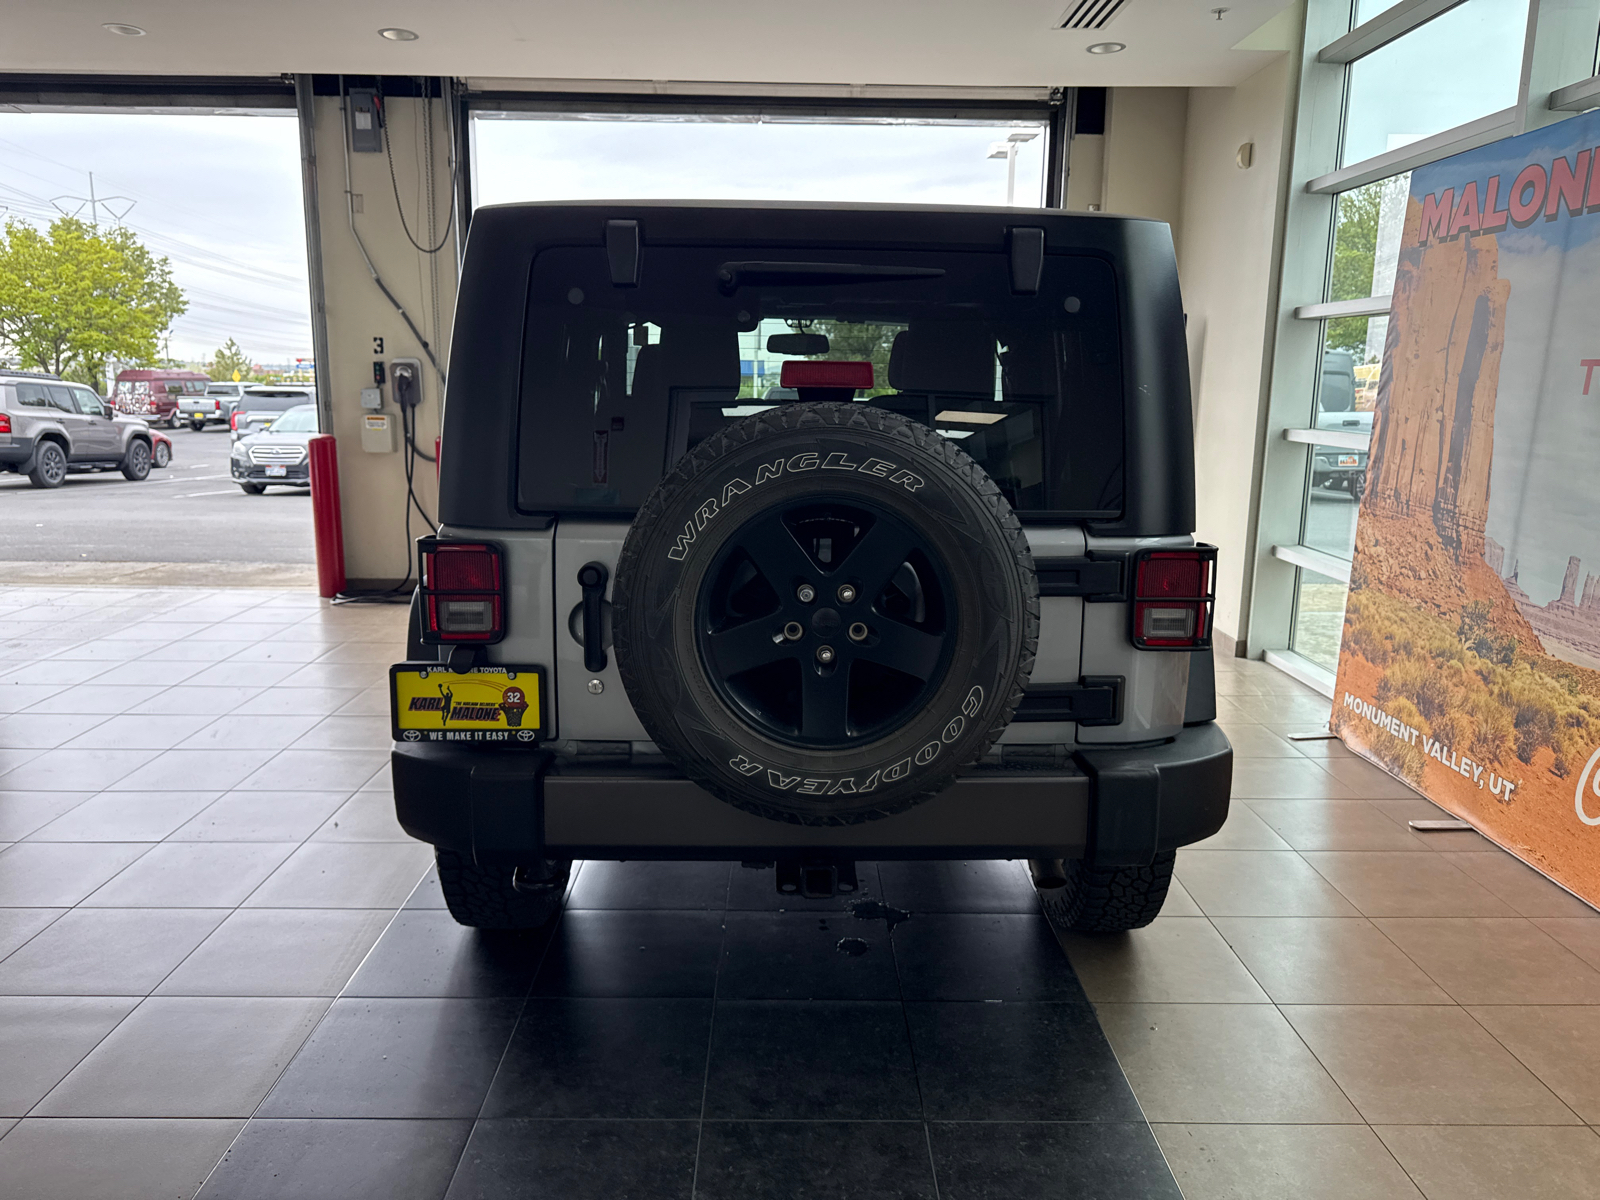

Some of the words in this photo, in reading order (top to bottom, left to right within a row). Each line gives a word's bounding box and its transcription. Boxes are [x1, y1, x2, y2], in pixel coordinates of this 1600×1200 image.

[373, 337, 384, 354] 3
[667, 452, 925, 561] WRANGLER
[408, 697, 443, 712] KARL
[507, 692, 521, 703] 32
[450, 706, 501, 722] MALONE
[429, 731, 443, 740] WE
[446, 731, 471, 740] MAKE
[475, 731, 484, 740] IT
[486, 731, 509, 740] EASY
[728, 685, 984, 795] GOODYEAR
[1343, 691, 1419, 746] MONUMENT
[1422, 735, 1484, 789] VALLEY,
[1488, 776, 1516, 802] UT
